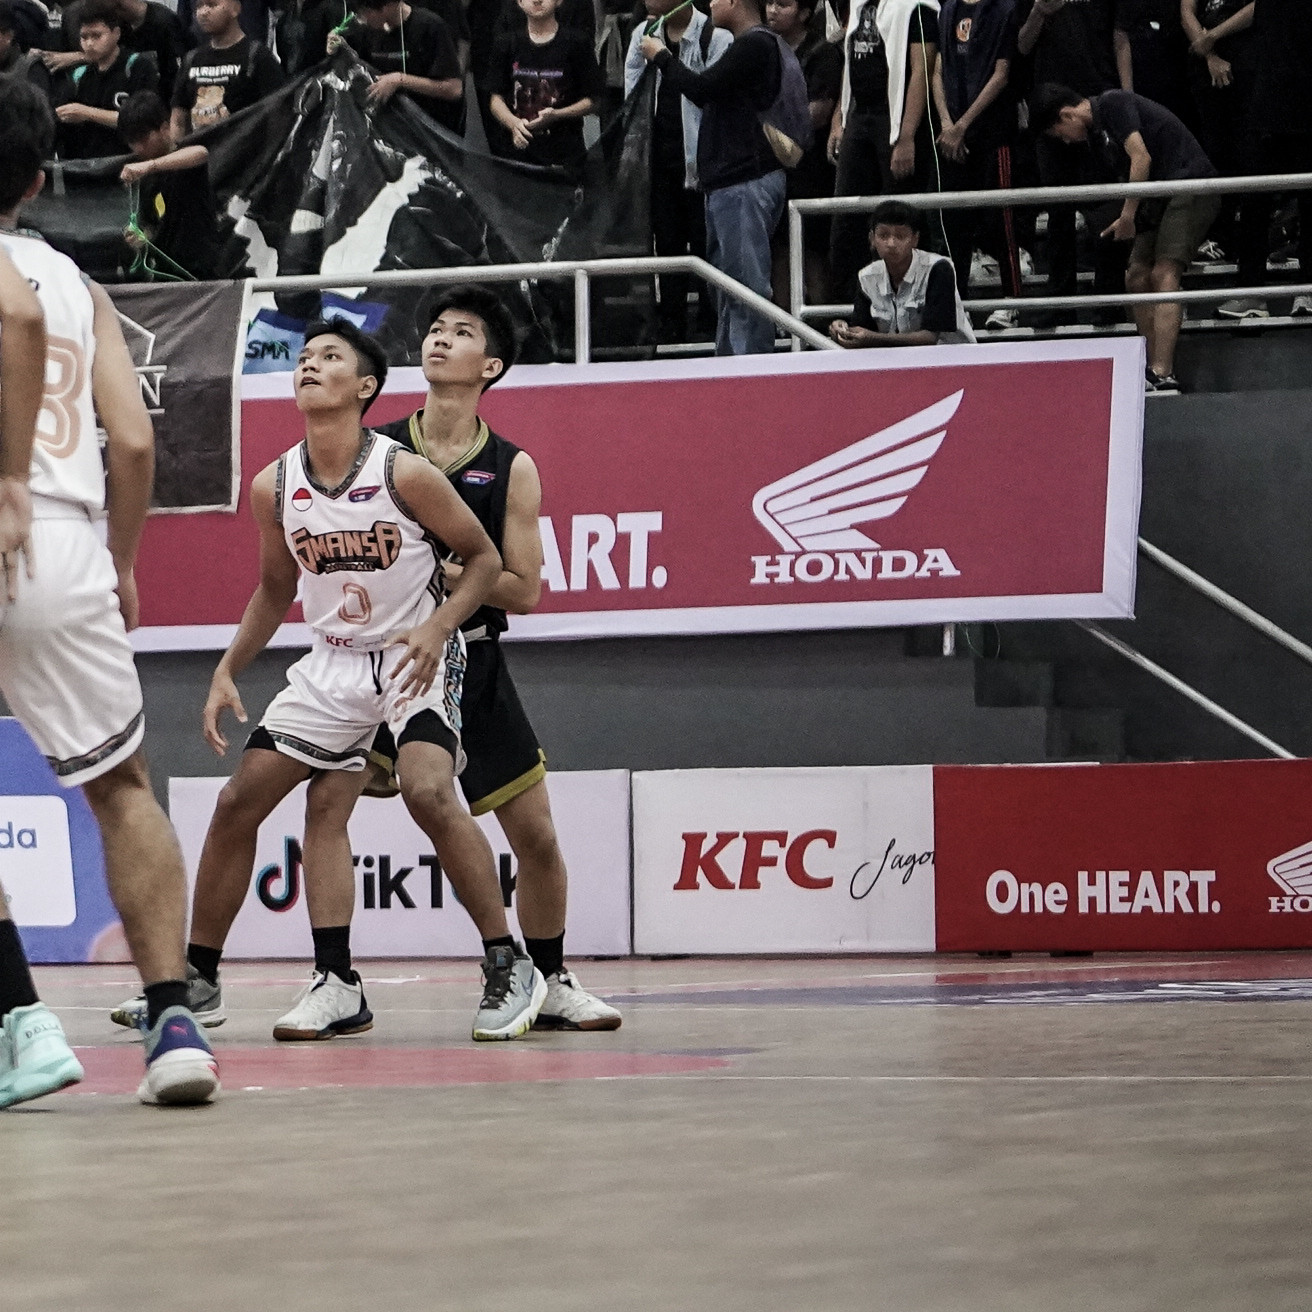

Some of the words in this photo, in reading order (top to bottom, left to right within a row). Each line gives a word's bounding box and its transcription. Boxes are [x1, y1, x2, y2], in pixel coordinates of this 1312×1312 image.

[291, 521, 402, 576] SMANSA
[750, 548, 961, 584] HONDA
[325, 635, 353, 649] KFC
[673, 829, 838, 891] KFC
[986, 869, 1069, 915] One
[1078, 870, 1222, 915] HEART.
